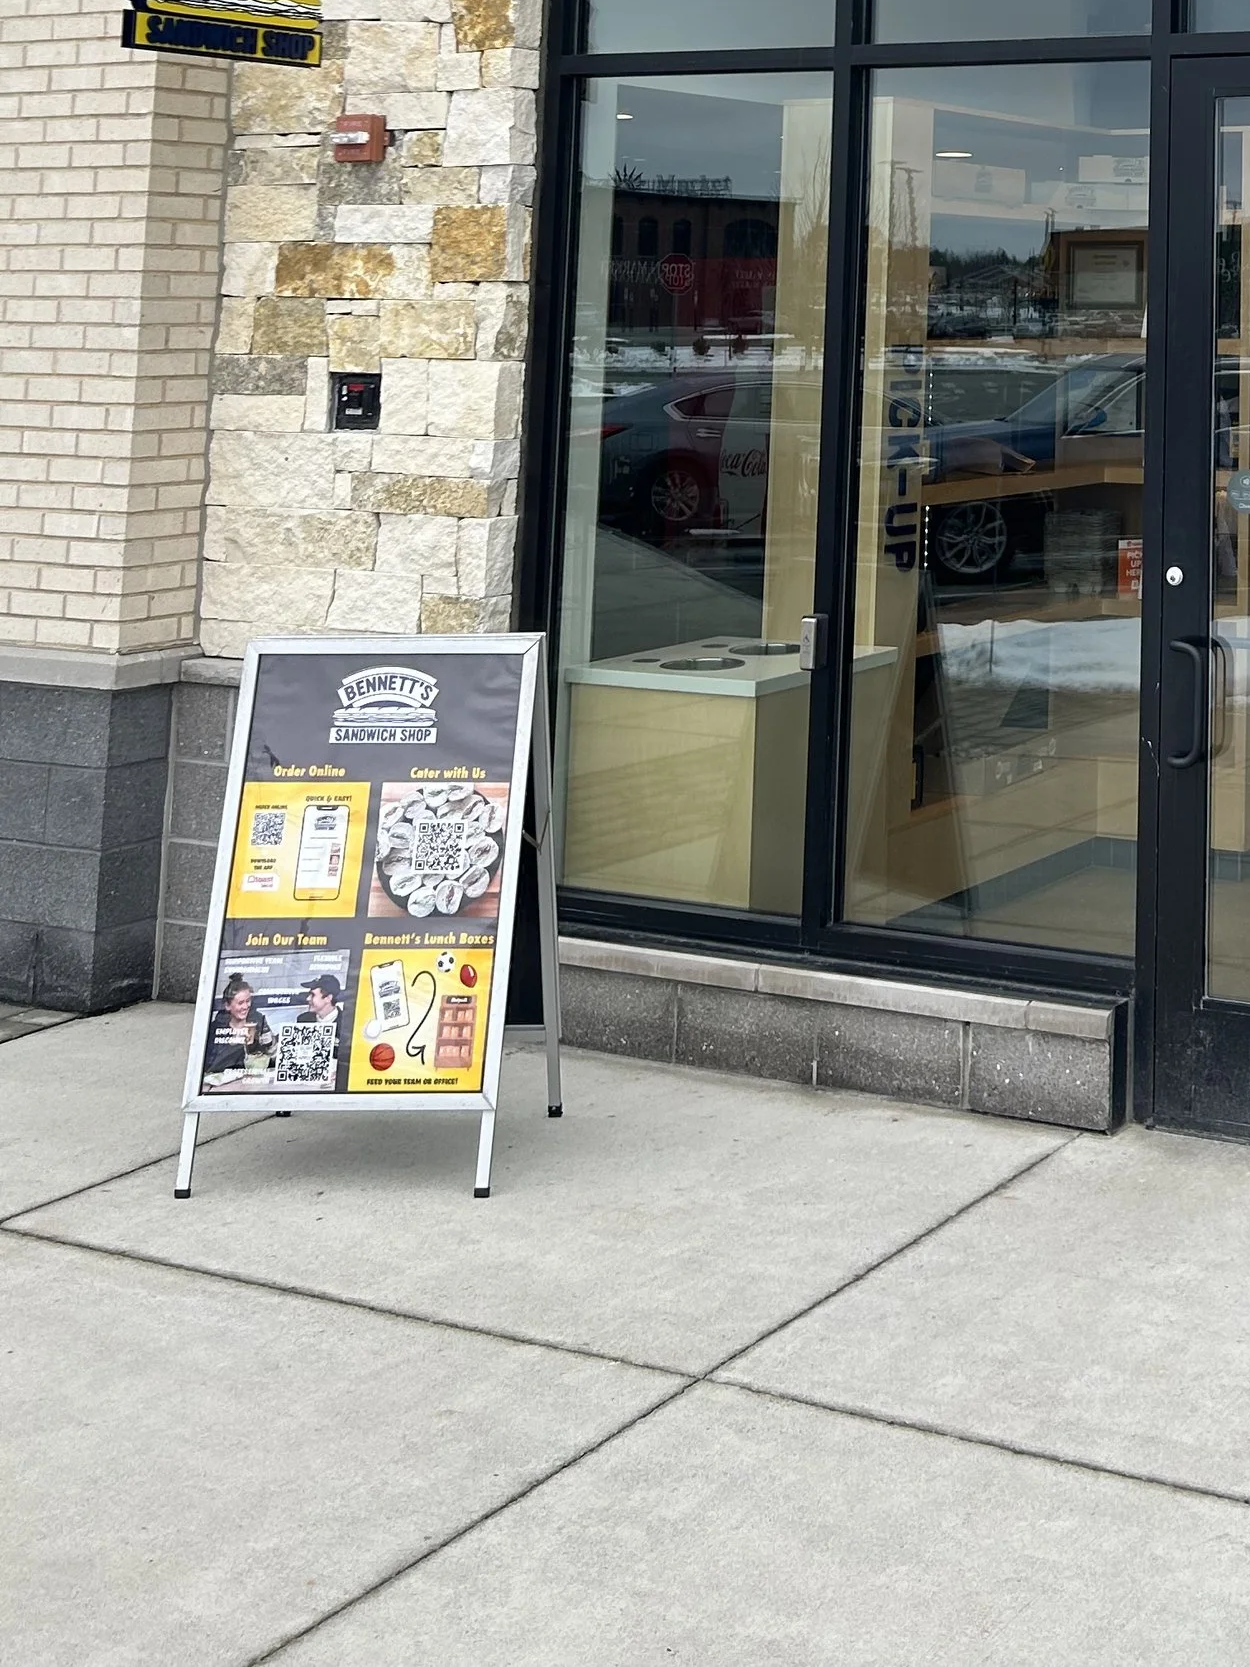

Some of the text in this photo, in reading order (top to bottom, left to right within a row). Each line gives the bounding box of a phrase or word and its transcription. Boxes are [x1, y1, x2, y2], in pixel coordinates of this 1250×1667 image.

[147, 15, 315, 60] SANDWICH SHOP
[343, 674, 434, 702] BENNETT'S
[335, 728, 432, 742] SANDWICH SHOP
[273, 765, 346, 777] Order Online
[410, 767, 487, 779] Cater with Us
[245, 933, 328, 946] Join Our Team
[364, 932, 495, 945] Bennett's Lunch Boxes
[366, 1078, 383, 1086] FEED
[403, 1078, 422, 1086] TEAM
[433, 1077, 459, 1086] OFFICE!
